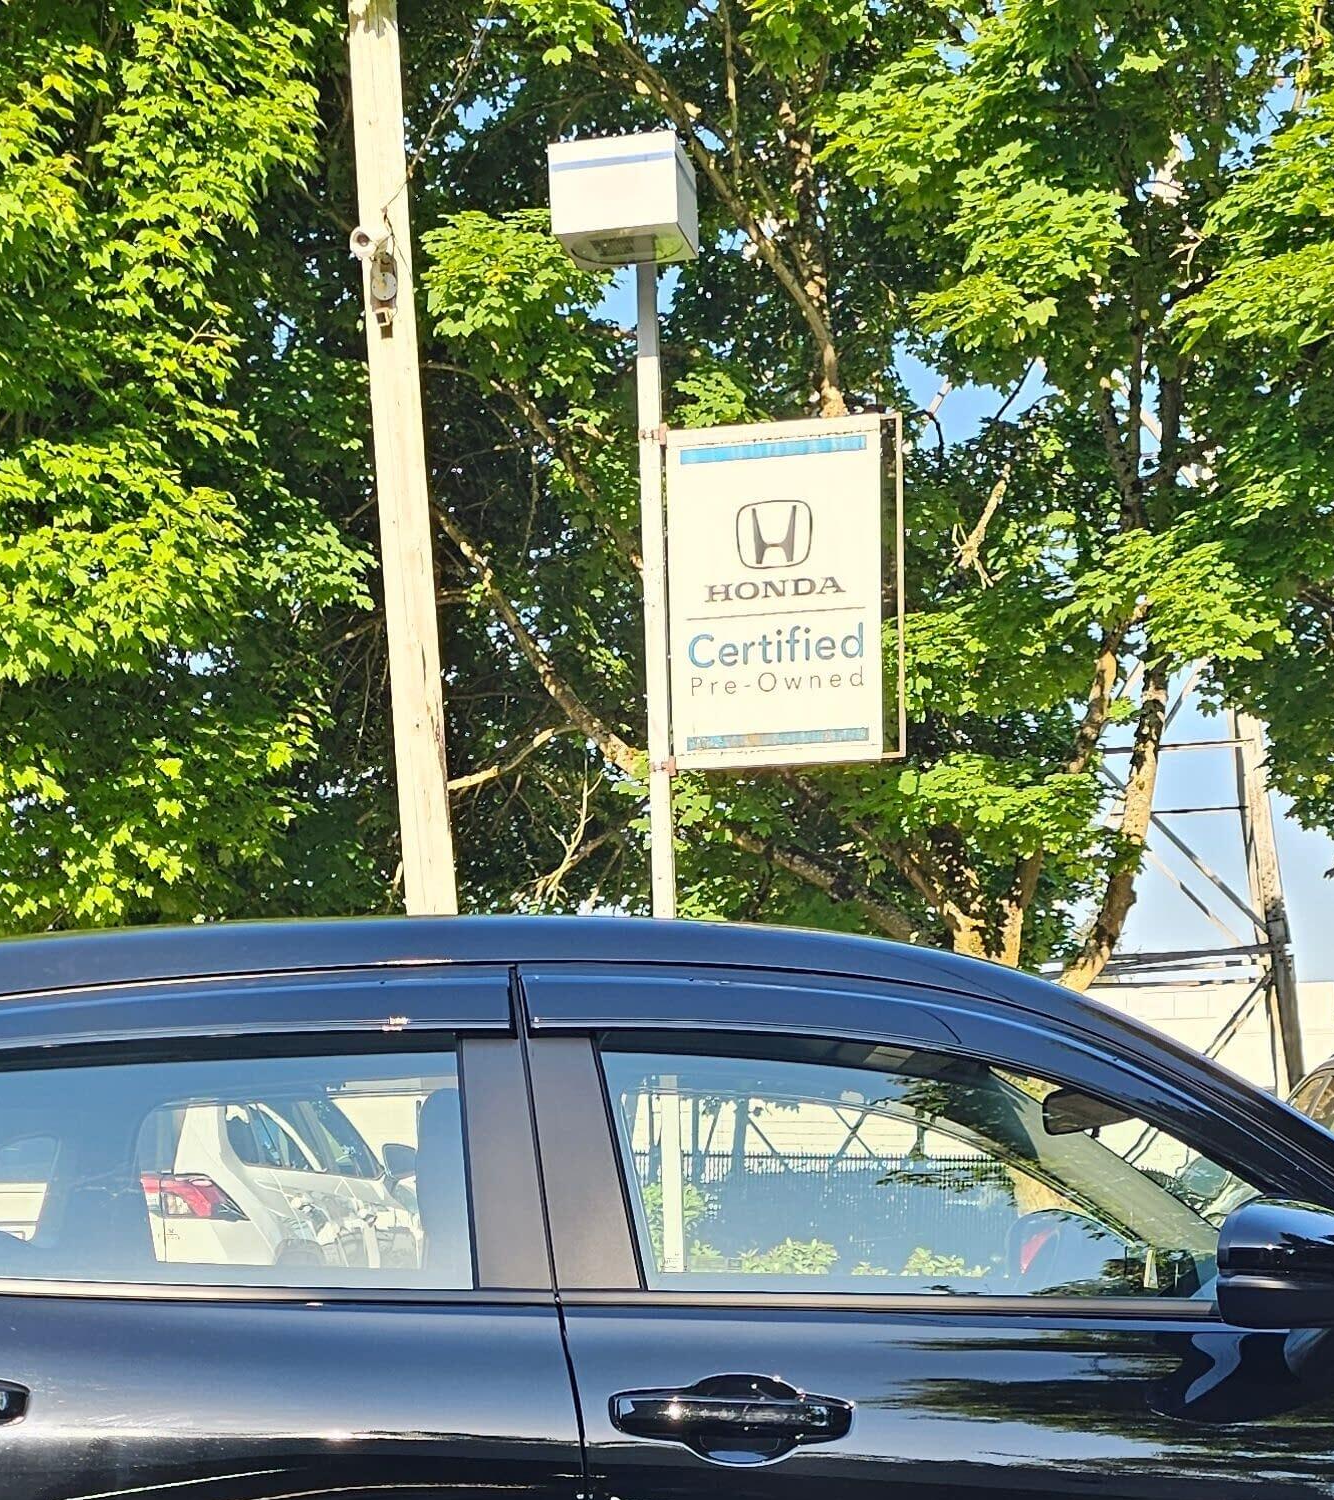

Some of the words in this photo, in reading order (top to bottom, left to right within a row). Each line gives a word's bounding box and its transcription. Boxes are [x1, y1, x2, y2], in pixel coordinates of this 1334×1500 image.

[705, 576, 846, 603] HONDA
[688, 622, 864, 668] Certified
[691, 666, 864, 697] Pre-Owned
